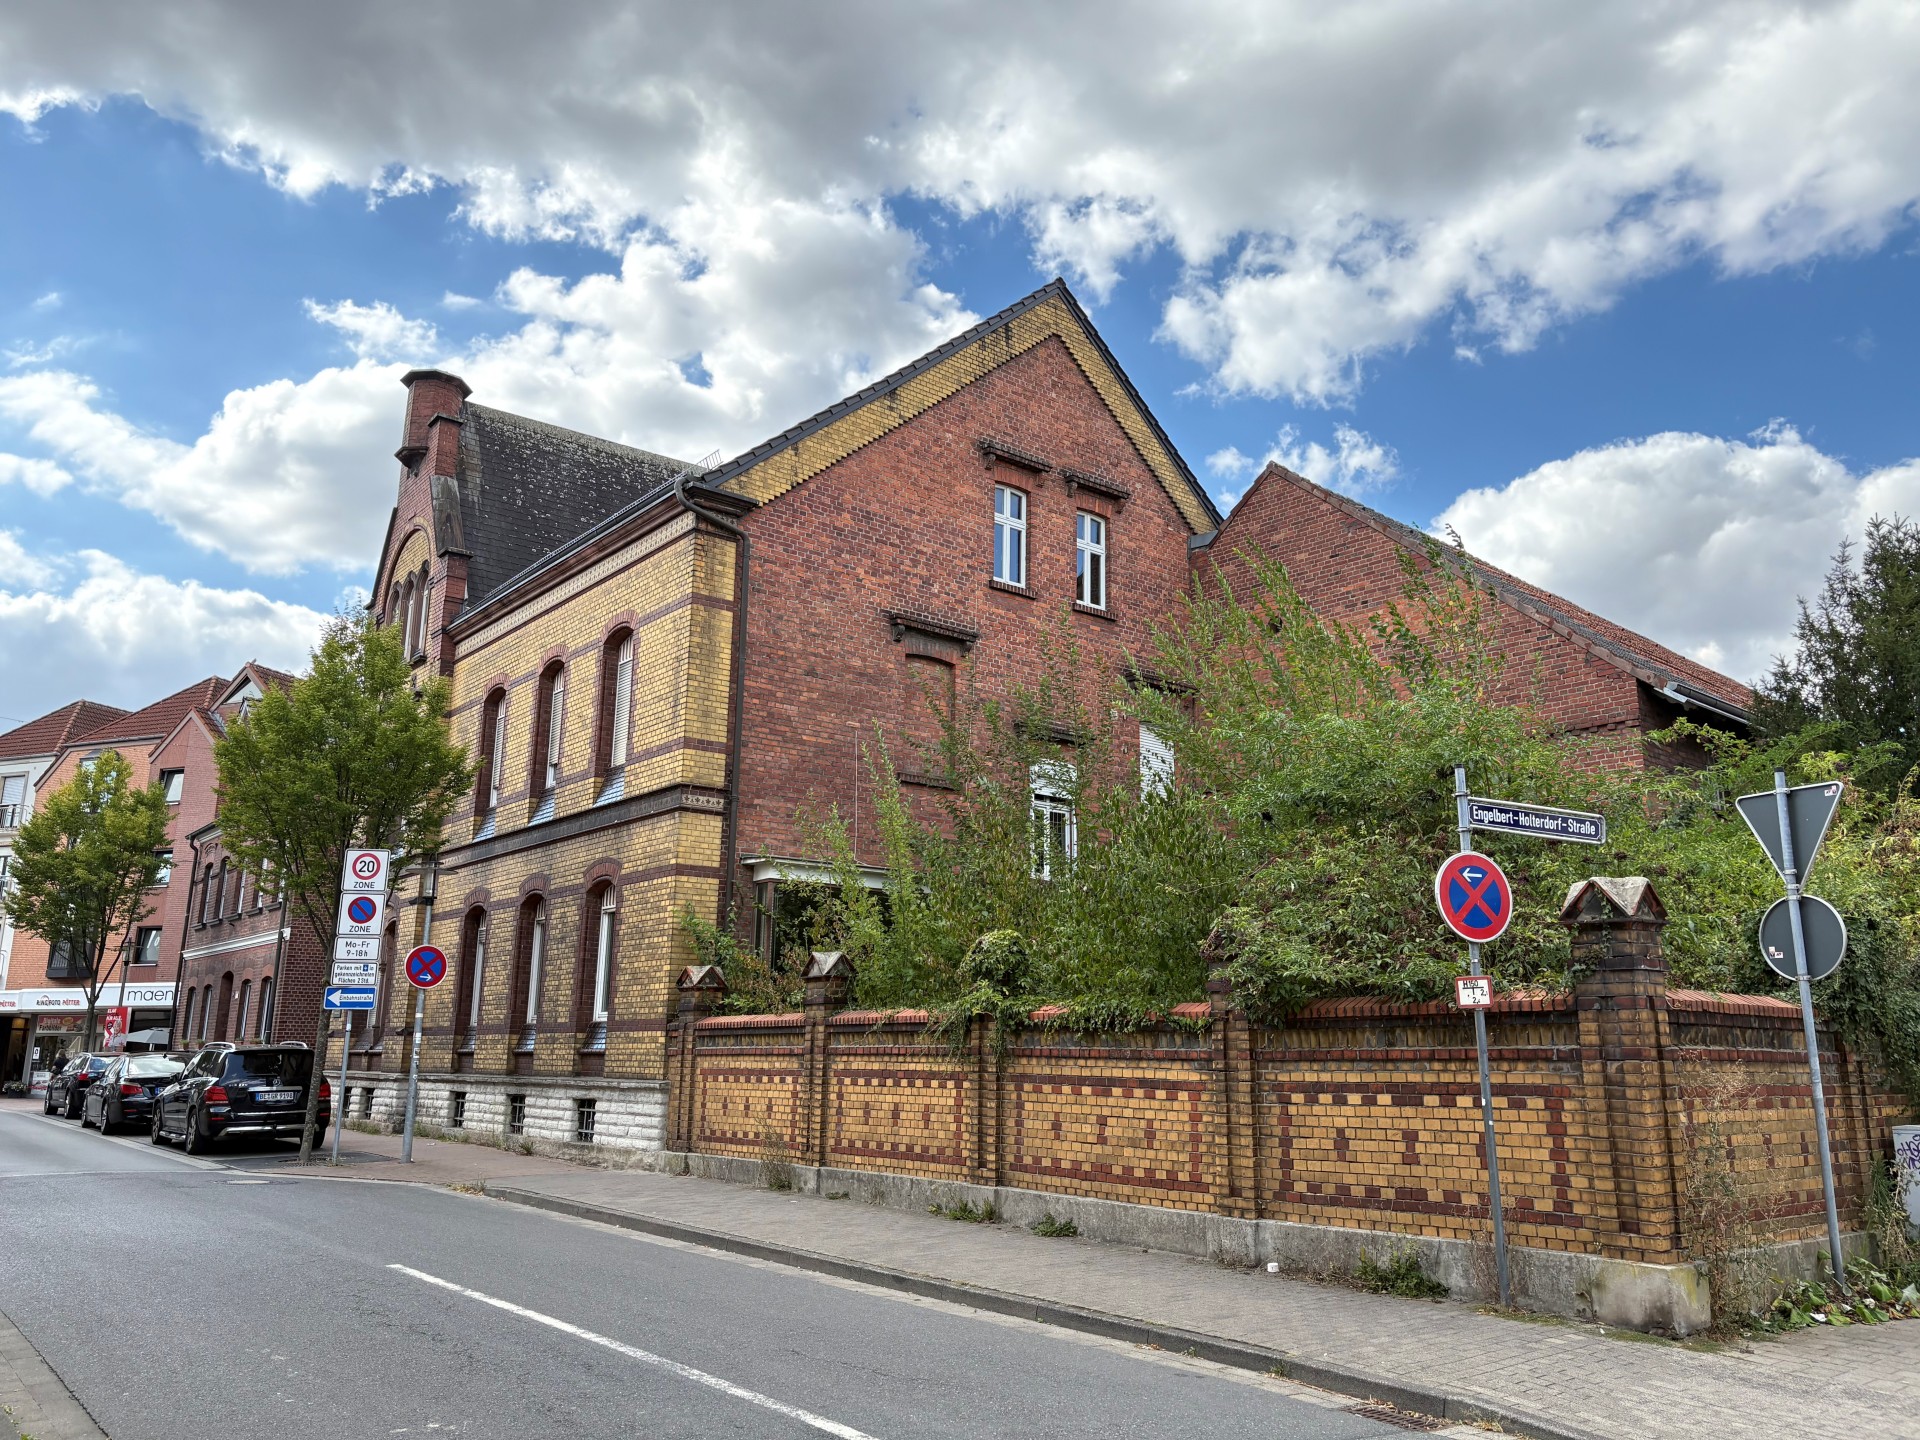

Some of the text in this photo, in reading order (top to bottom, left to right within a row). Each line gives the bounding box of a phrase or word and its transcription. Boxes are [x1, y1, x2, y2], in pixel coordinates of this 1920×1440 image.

[1473, 806, 1596, 835] Engelbert-Holterdorf-Straße
[358, 860, 375, 873] 20
[353, 881, 375, 889] ZONE
[349, 925, 371, 933] ZONE
